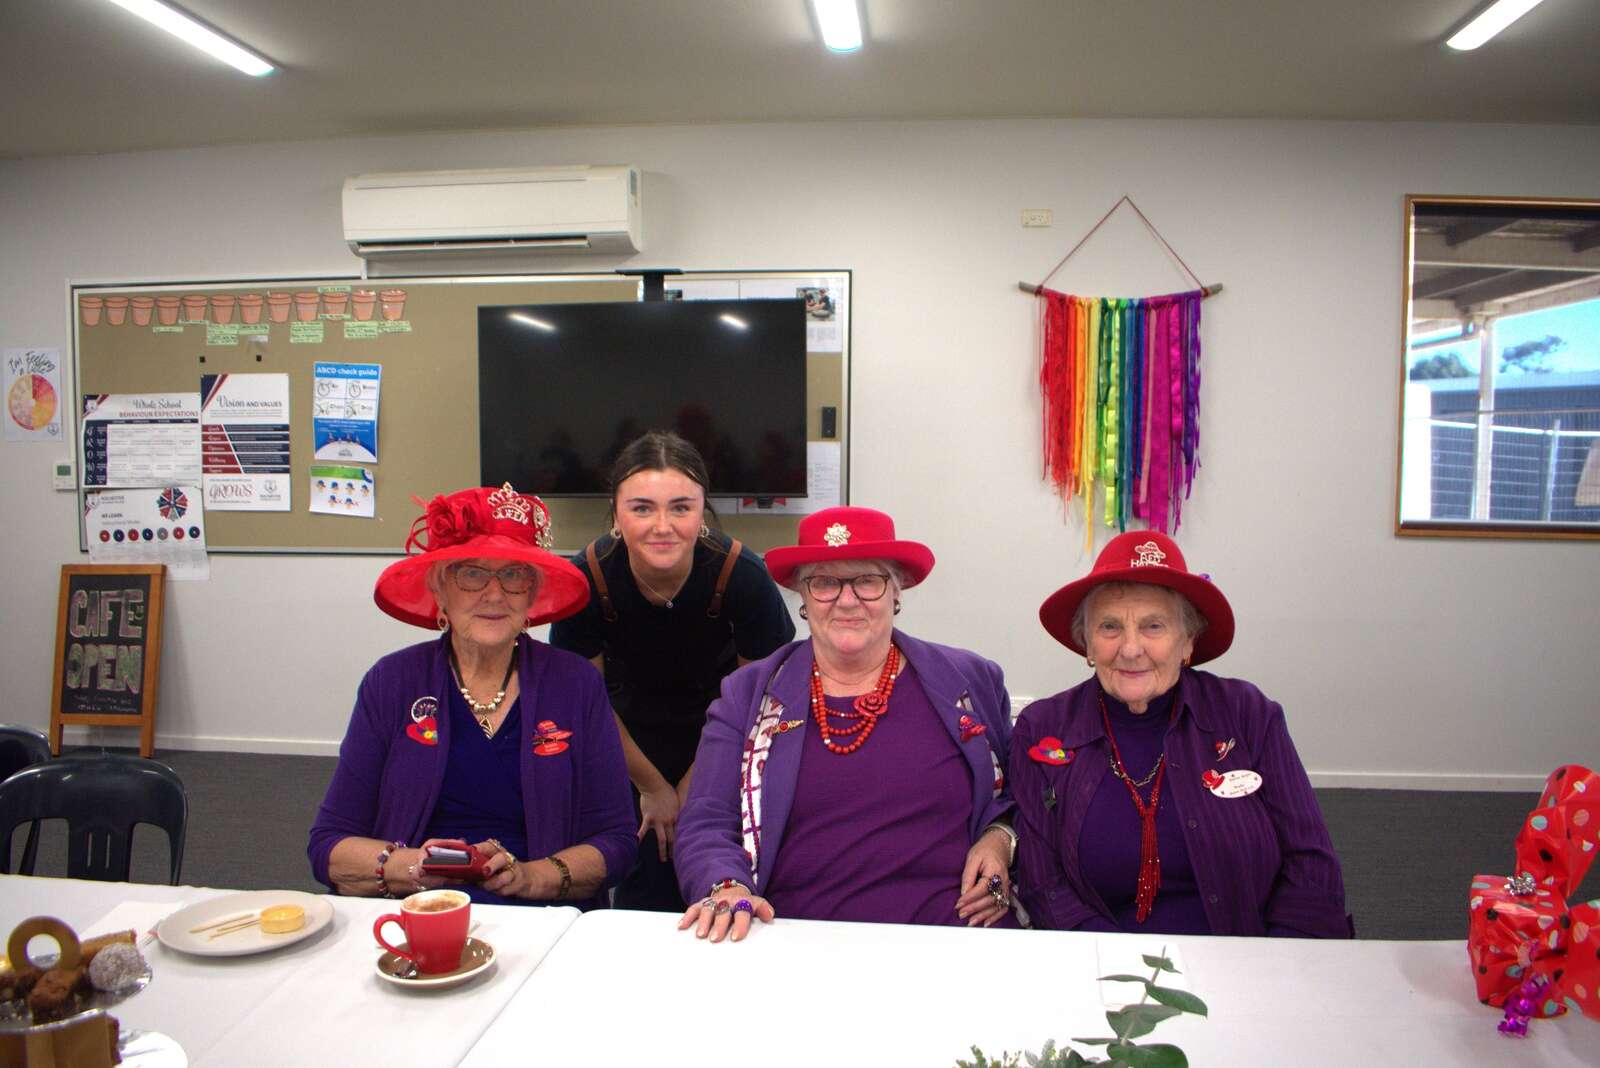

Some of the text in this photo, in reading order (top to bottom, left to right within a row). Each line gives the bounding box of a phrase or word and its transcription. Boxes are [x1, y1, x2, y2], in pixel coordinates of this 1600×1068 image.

[158, 398, 182, 409] School
[69, 589, 144, 638] CAFE
[66, 643, 143, 694] OPEN
